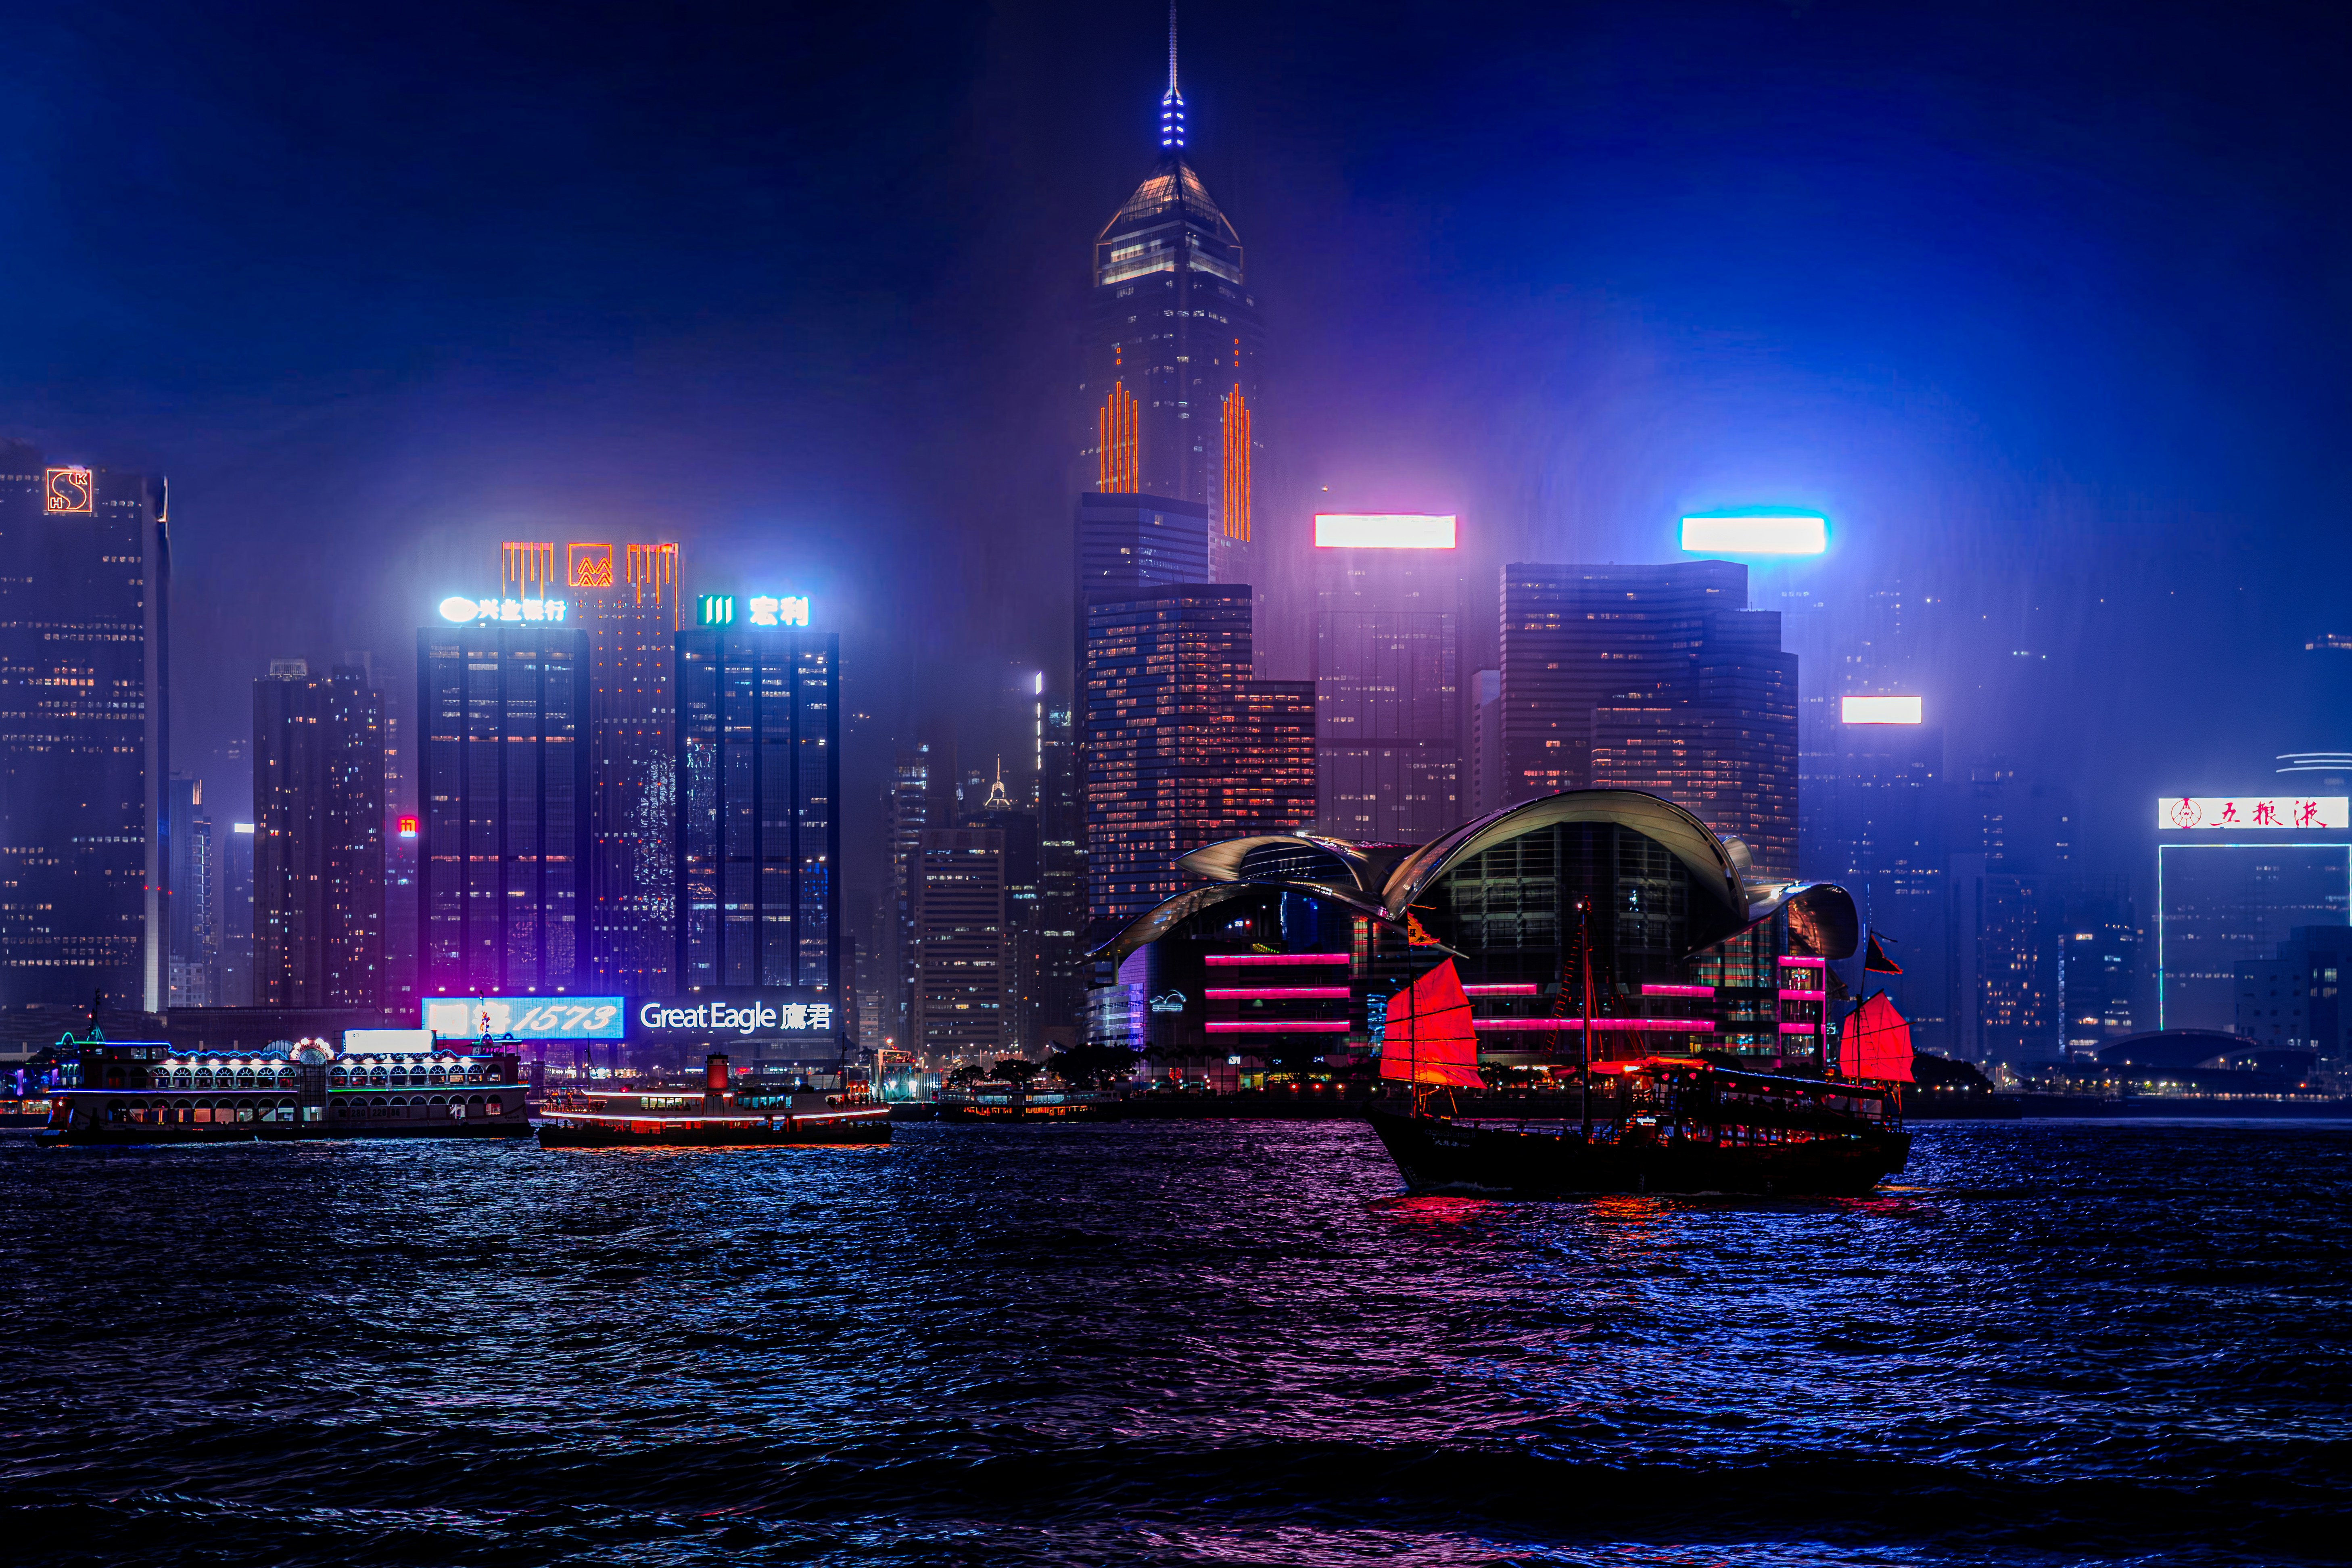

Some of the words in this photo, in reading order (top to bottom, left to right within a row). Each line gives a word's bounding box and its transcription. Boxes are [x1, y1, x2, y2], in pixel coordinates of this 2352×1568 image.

[750, 595, 808, 626] 宏利
[2209, 800, 2328, 828] 五粮液
[512, 1005, 616, 1030] 1573
[640, 1002, 708, 1028] Great
[711, 1001, 776, 1034] Eagle
[351, 1109, 366, 1117] 280
[1425, 1129, 1469, 1140] aqualuna
